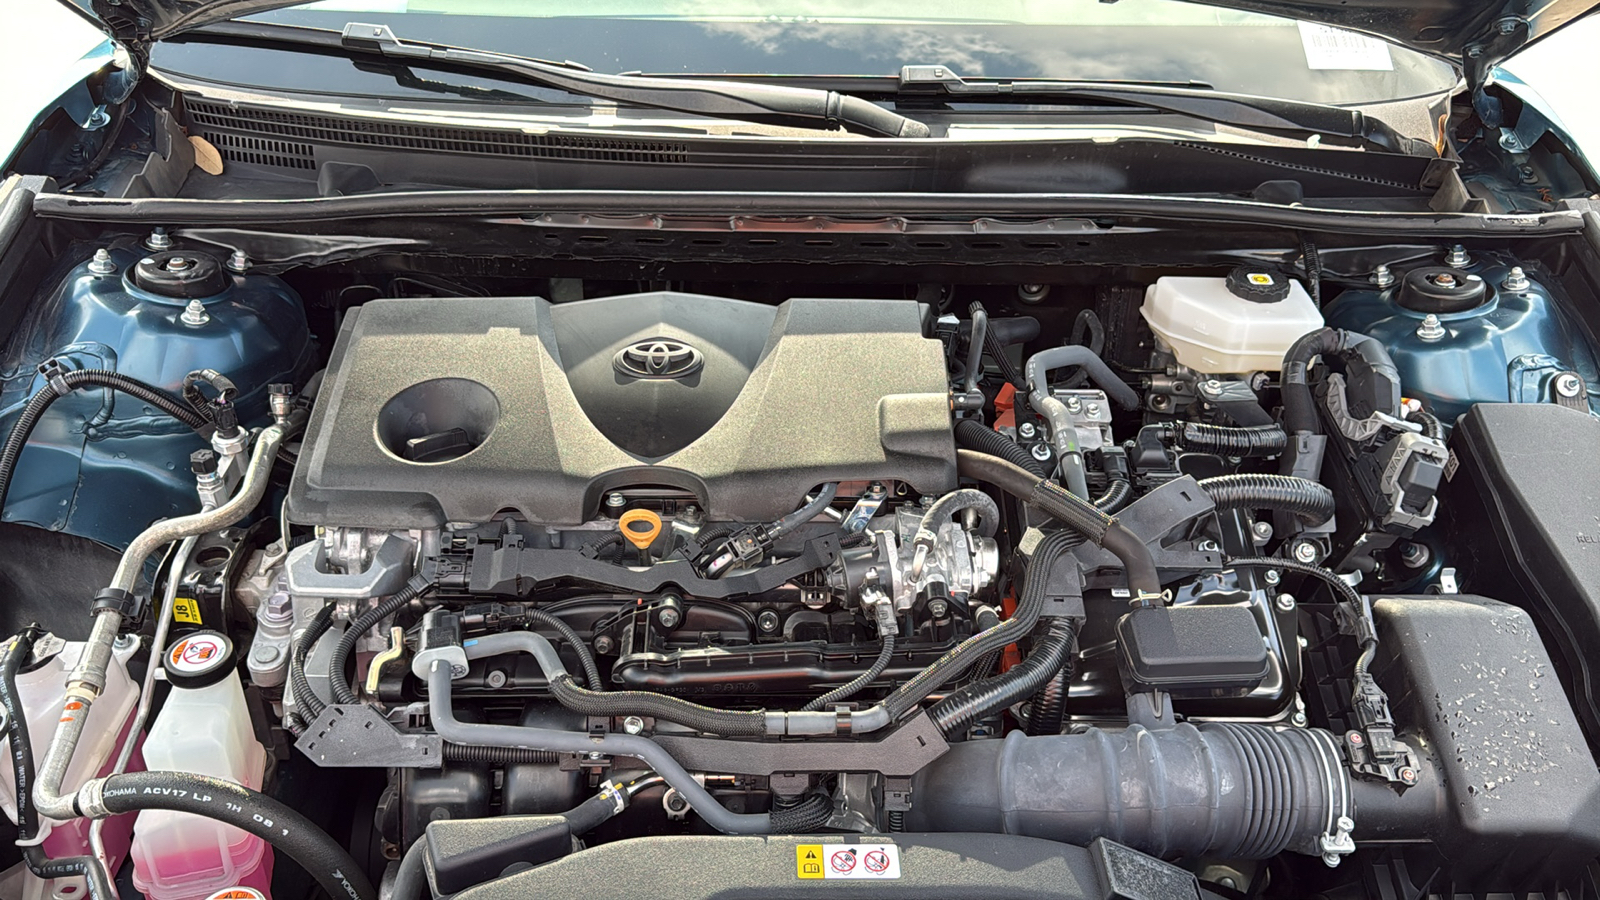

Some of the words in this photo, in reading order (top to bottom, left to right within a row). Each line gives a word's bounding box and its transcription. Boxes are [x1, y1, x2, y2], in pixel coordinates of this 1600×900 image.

[1576, 535, 1600, 543] REL
[175, 604, 190, 618] J8
[18, 764, 26, 788] WATER
[143, 786, 188, 798] ACV17
[193, 792, 212, 802] LP
[226, 802, 242, 813] 1H
[341, 878, 362, 900] YOKOH
